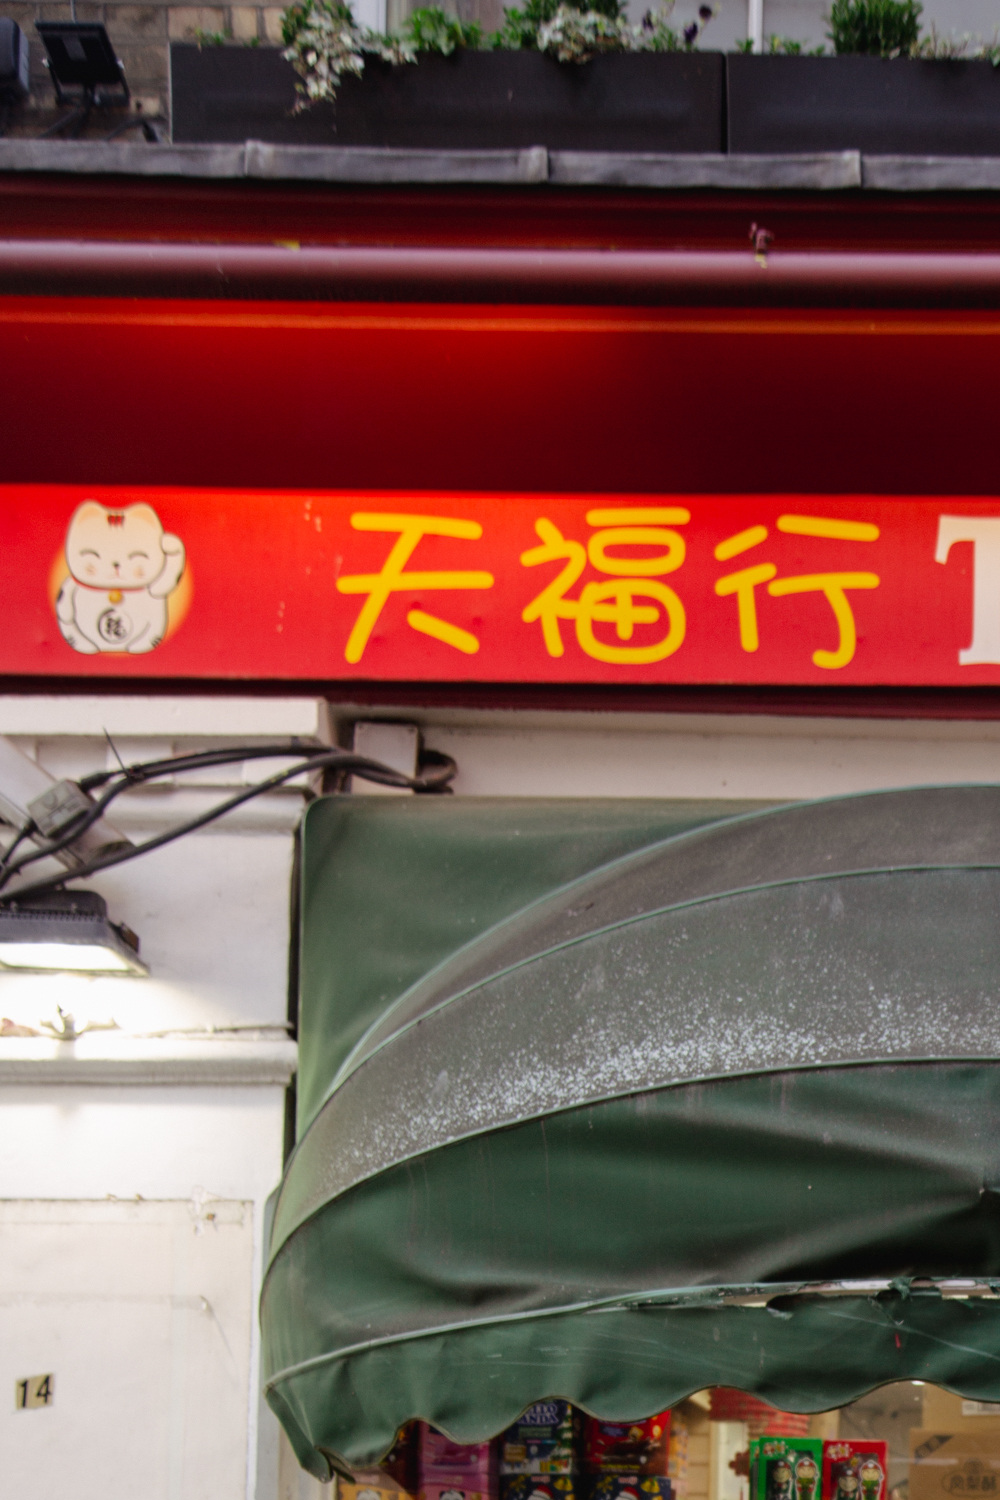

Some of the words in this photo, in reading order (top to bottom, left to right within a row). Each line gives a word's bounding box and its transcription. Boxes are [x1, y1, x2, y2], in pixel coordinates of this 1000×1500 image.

[336, 506, 881, 671] 天福行
[20, 1375, 52, 1409] 14
